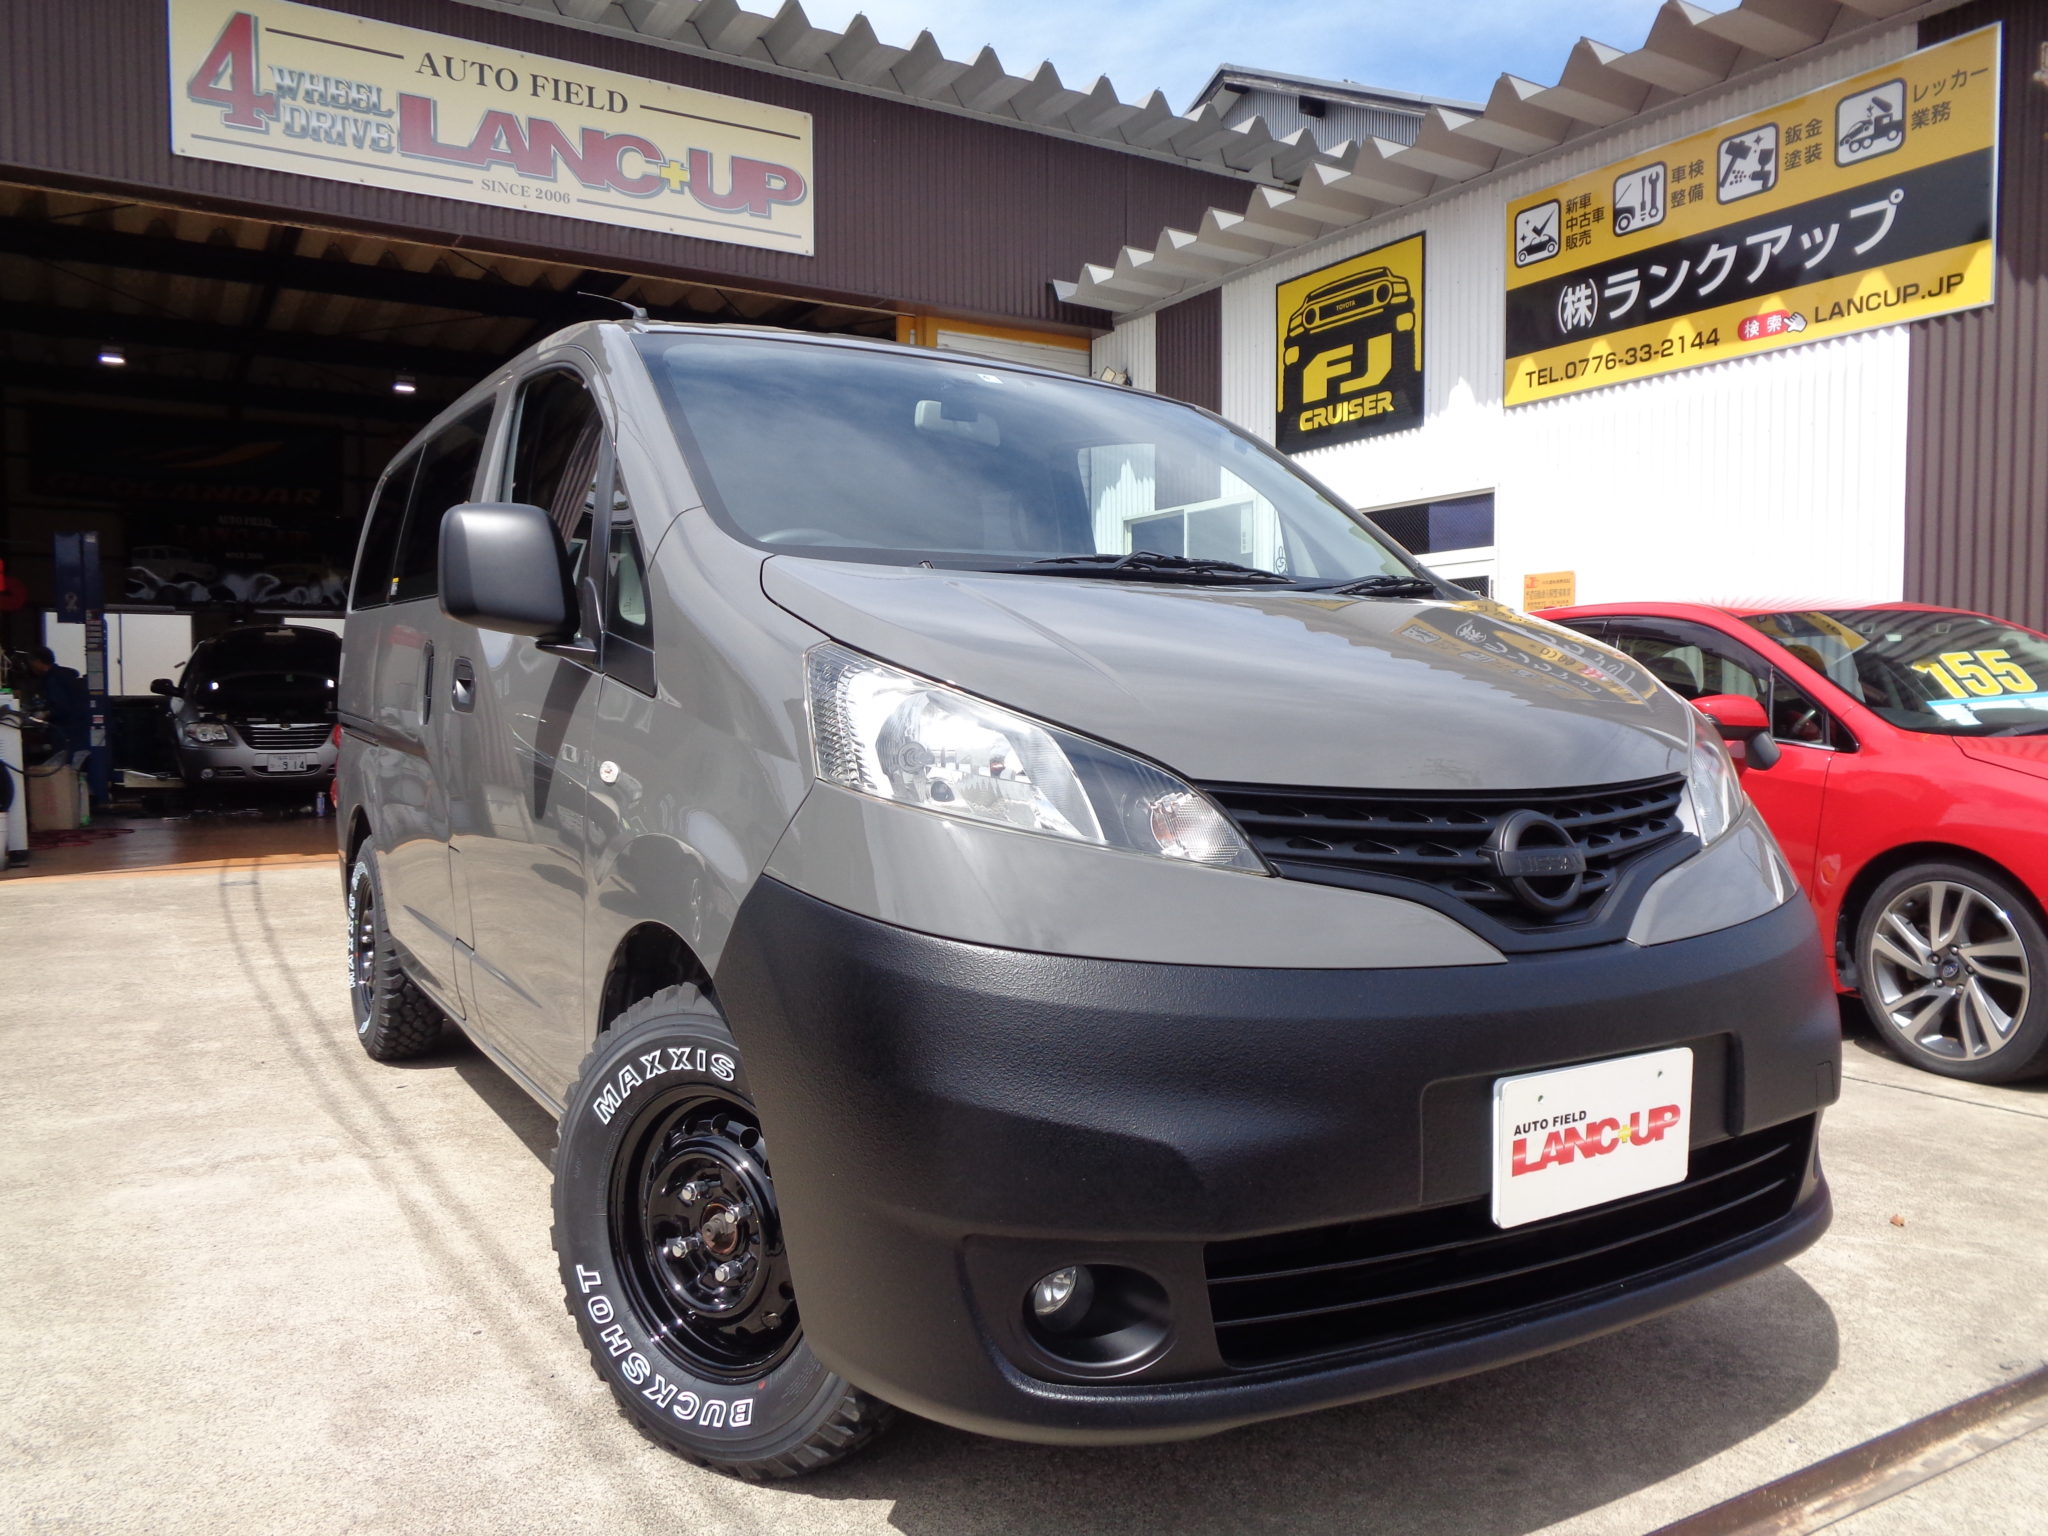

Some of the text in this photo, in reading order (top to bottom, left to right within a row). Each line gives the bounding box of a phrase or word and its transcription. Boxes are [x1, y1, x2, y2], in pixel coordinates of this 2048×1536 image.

[187, 10, 280, 134] 4
[415, 52, 629, 114] AUTO FIELD
[1913, 66, 1989, 103] レッカー
[268, 64, 395, 118] WHEEL
[282, 104, 395, 153] DRIVE
[1911, 101, 1952, 131] 業務
[1785, 118, 1823, 146] 鈑金
[1671, 159, 1705, 185] 車検
[1784, 143, 1823, 171] 塗装
[481, 179, 571, 205] SINCE 2006
[1565, 192, 1592, 216] 新車
[1670, 183, 1705, 209] 整備
[1565, 206, 1606, 233] 中古車
[1565, 229, 1592, 251] 販売
[1335, 299, 1356, 312] TOYOTA
[1815, 272, 1965, 324] LANCUP.JP
[1744, 313, 1783, 338] 検索
[1303, 332, 1393, 404] FJ
[1300, 390, 1395, 432] CRUISER
[1911, 649, 2038, 699] 155
[593, 1047, 736, 1126] MAXXIS
[1514, 1110, 1587, 1136] AUTO FIELD
[576, 1264, 753, 1428] BUCKSHOT
